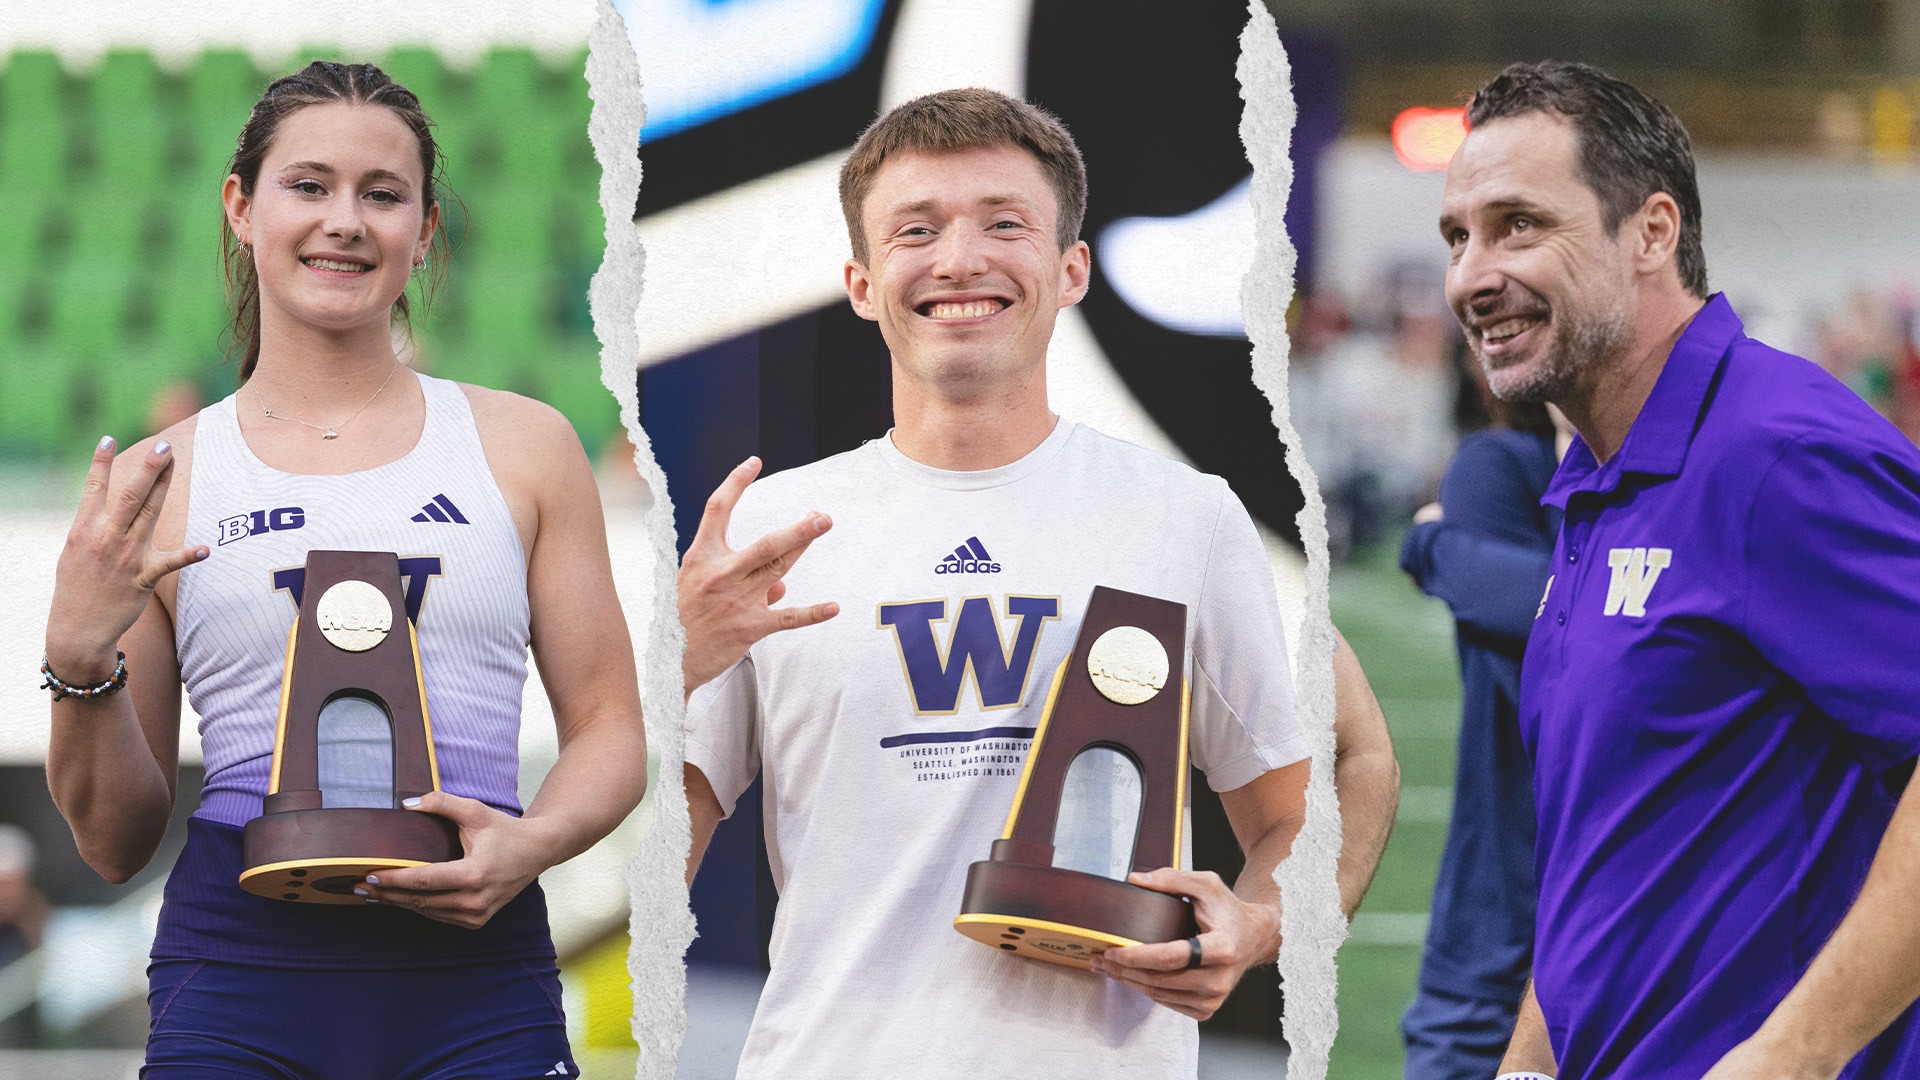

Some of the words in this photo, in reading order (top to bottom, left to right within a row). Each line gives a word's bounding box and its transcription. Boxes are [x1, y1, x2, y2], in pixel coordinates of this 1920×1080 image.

[934, 560, 1002, 574] adidas
[1603, 547, 1673, 618] W
[876, 593, 1062, 717] W
[900, 747, 956, 758] UNIVERSITY
[960, 746, 970, 754] OF
[961, 755, 1020, 765] WASHINGTON
[917, 769, 978, 781] ESTABLISHED
[983, 768, 992, 776] IN
[996, 768, 1015, 776] 1861
